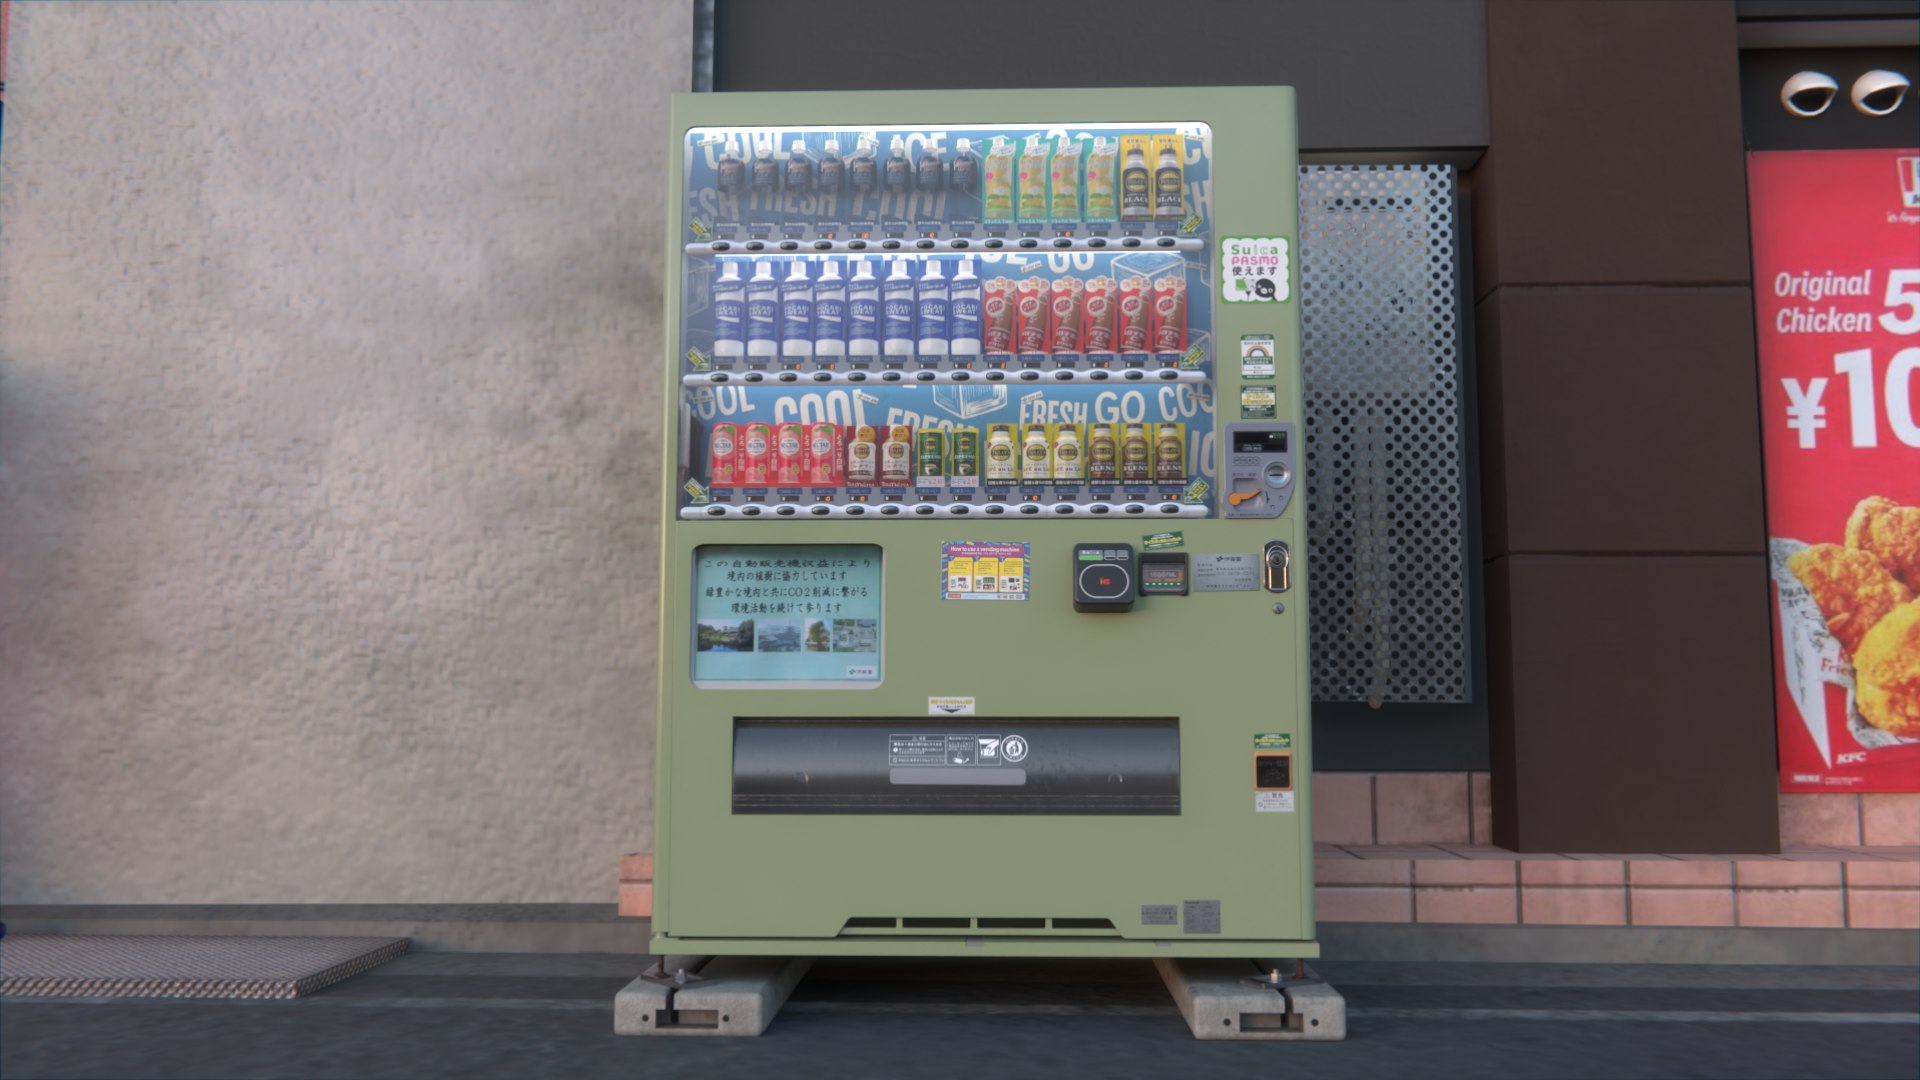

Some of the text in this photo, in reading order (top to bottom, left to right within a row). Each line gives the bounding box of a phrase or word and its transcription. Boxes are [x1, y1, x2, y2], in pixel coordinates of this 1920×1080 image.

[1231, 244, 1278, 255] Suica
[1231, 256, 1279, 266] PASMO
[1232, 266, 1278, 276] 使えます
[1775, 270, 1872, 300] Original
[1776, 307, 1872, 333] Chicken
[1095, 390, 1146, 424] GO
[1836, 752, 1867, 764] KFC
